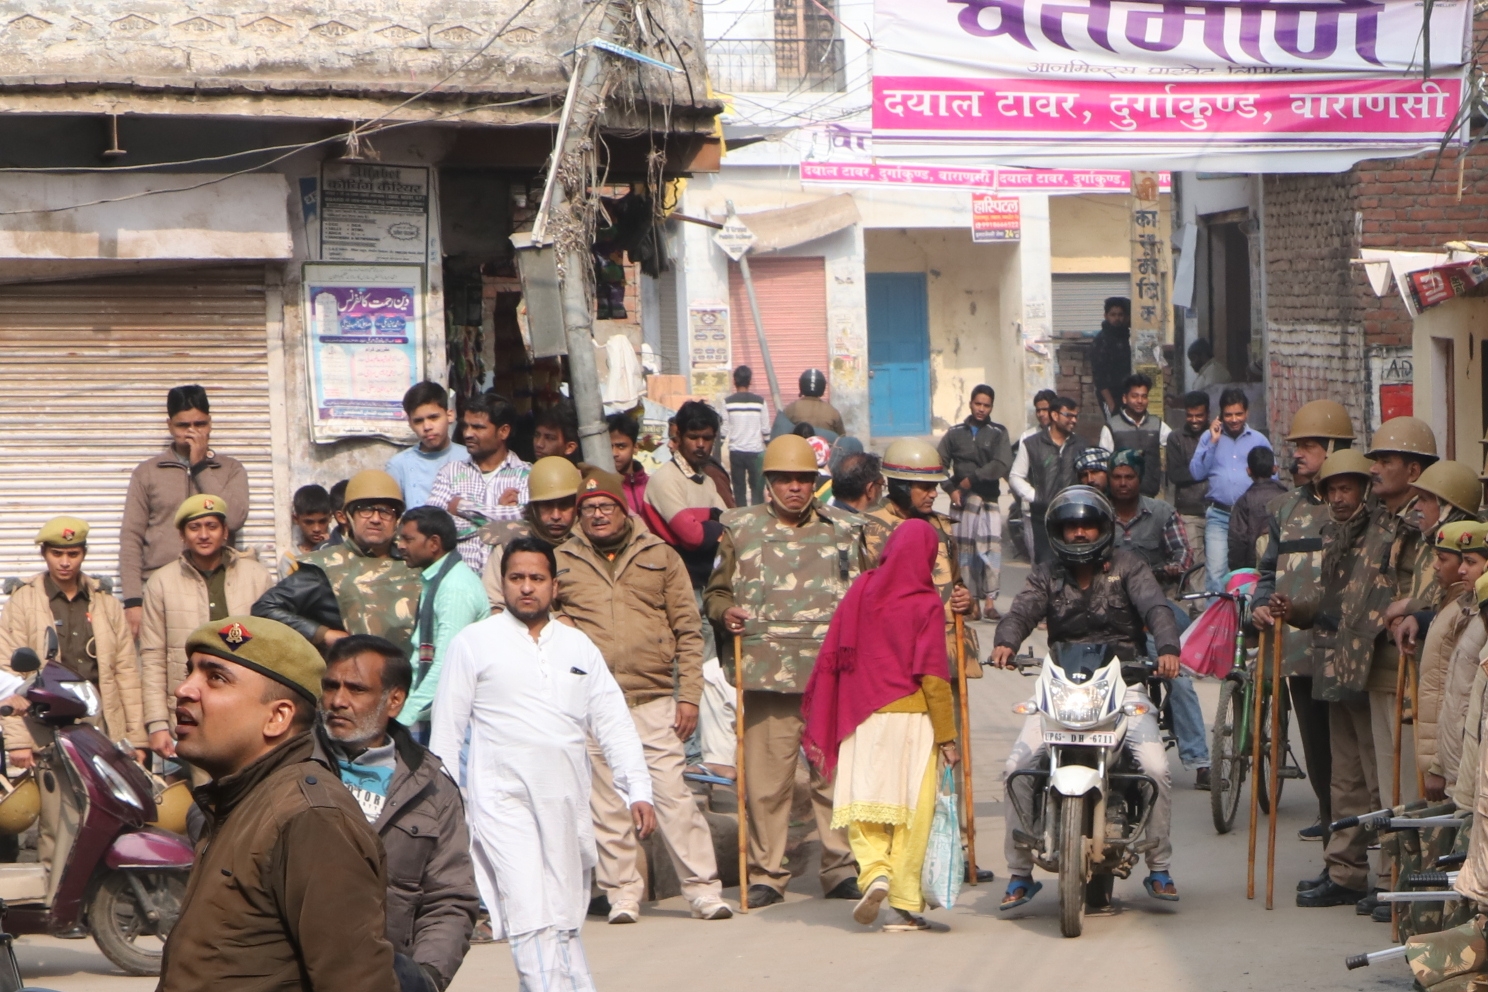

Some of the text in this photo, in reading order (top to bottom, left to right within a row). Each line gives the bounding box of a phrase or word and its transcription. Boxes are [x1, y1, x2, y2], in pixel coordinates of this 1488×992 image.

[883, 81, 1449, 131] दयाल टावर, दुर्गाकुण्ड, वाराणसी
[804, 166, 838, 178] दयाल
[938, 168, 991, 184] वाराणसी
[999, 171, 1033, 185] दयाल
[1005, 230, 1014, 238] 24
[1386, 359, 1412, 379] AD
[348, 785, 381, 806] OTOR
